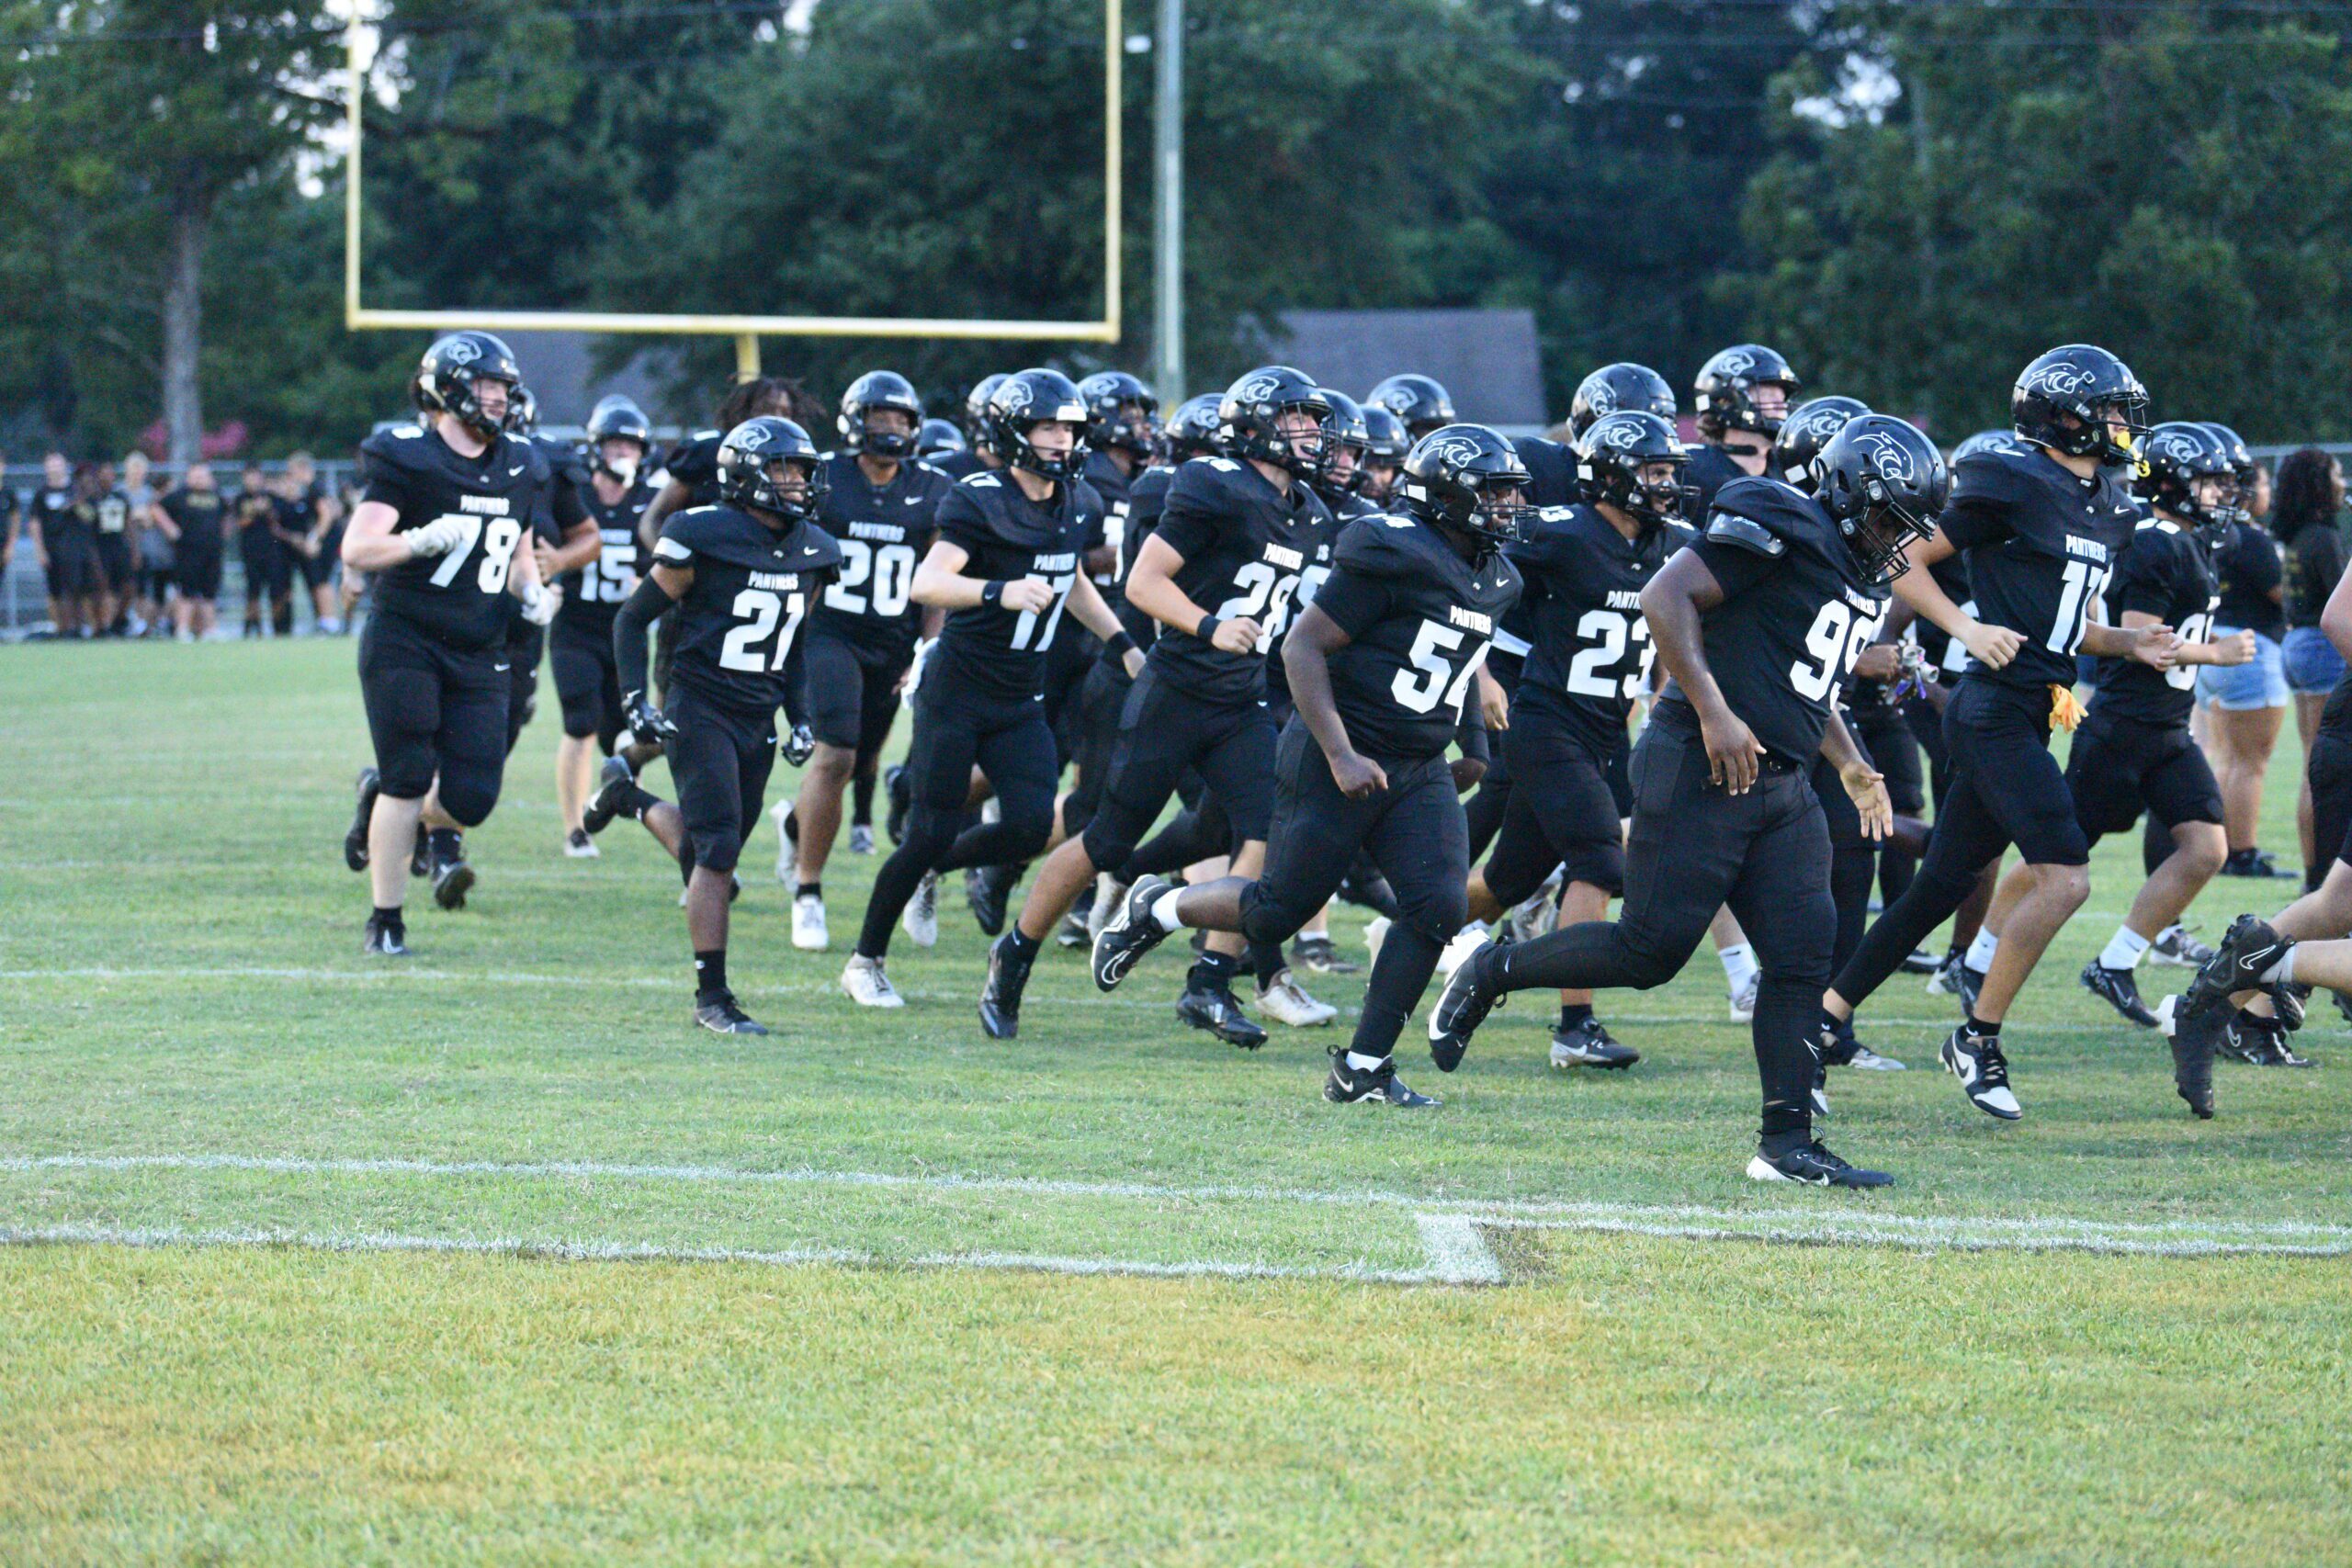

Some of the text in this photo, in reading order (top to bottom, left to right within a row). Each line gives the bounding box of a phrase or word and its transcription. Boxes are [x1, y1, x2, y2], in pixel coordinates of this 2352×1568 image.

[429, 513, 522, 594] 78
[580, 544, 638, 603] 15
[824, 538, 916, 616] 20
[718, 589, 805, 672] 21
[1010, 572, 1077, 652] 17
[1214, 561, 1301, 655] 28
[1566, 609, 1657, 699] 23
